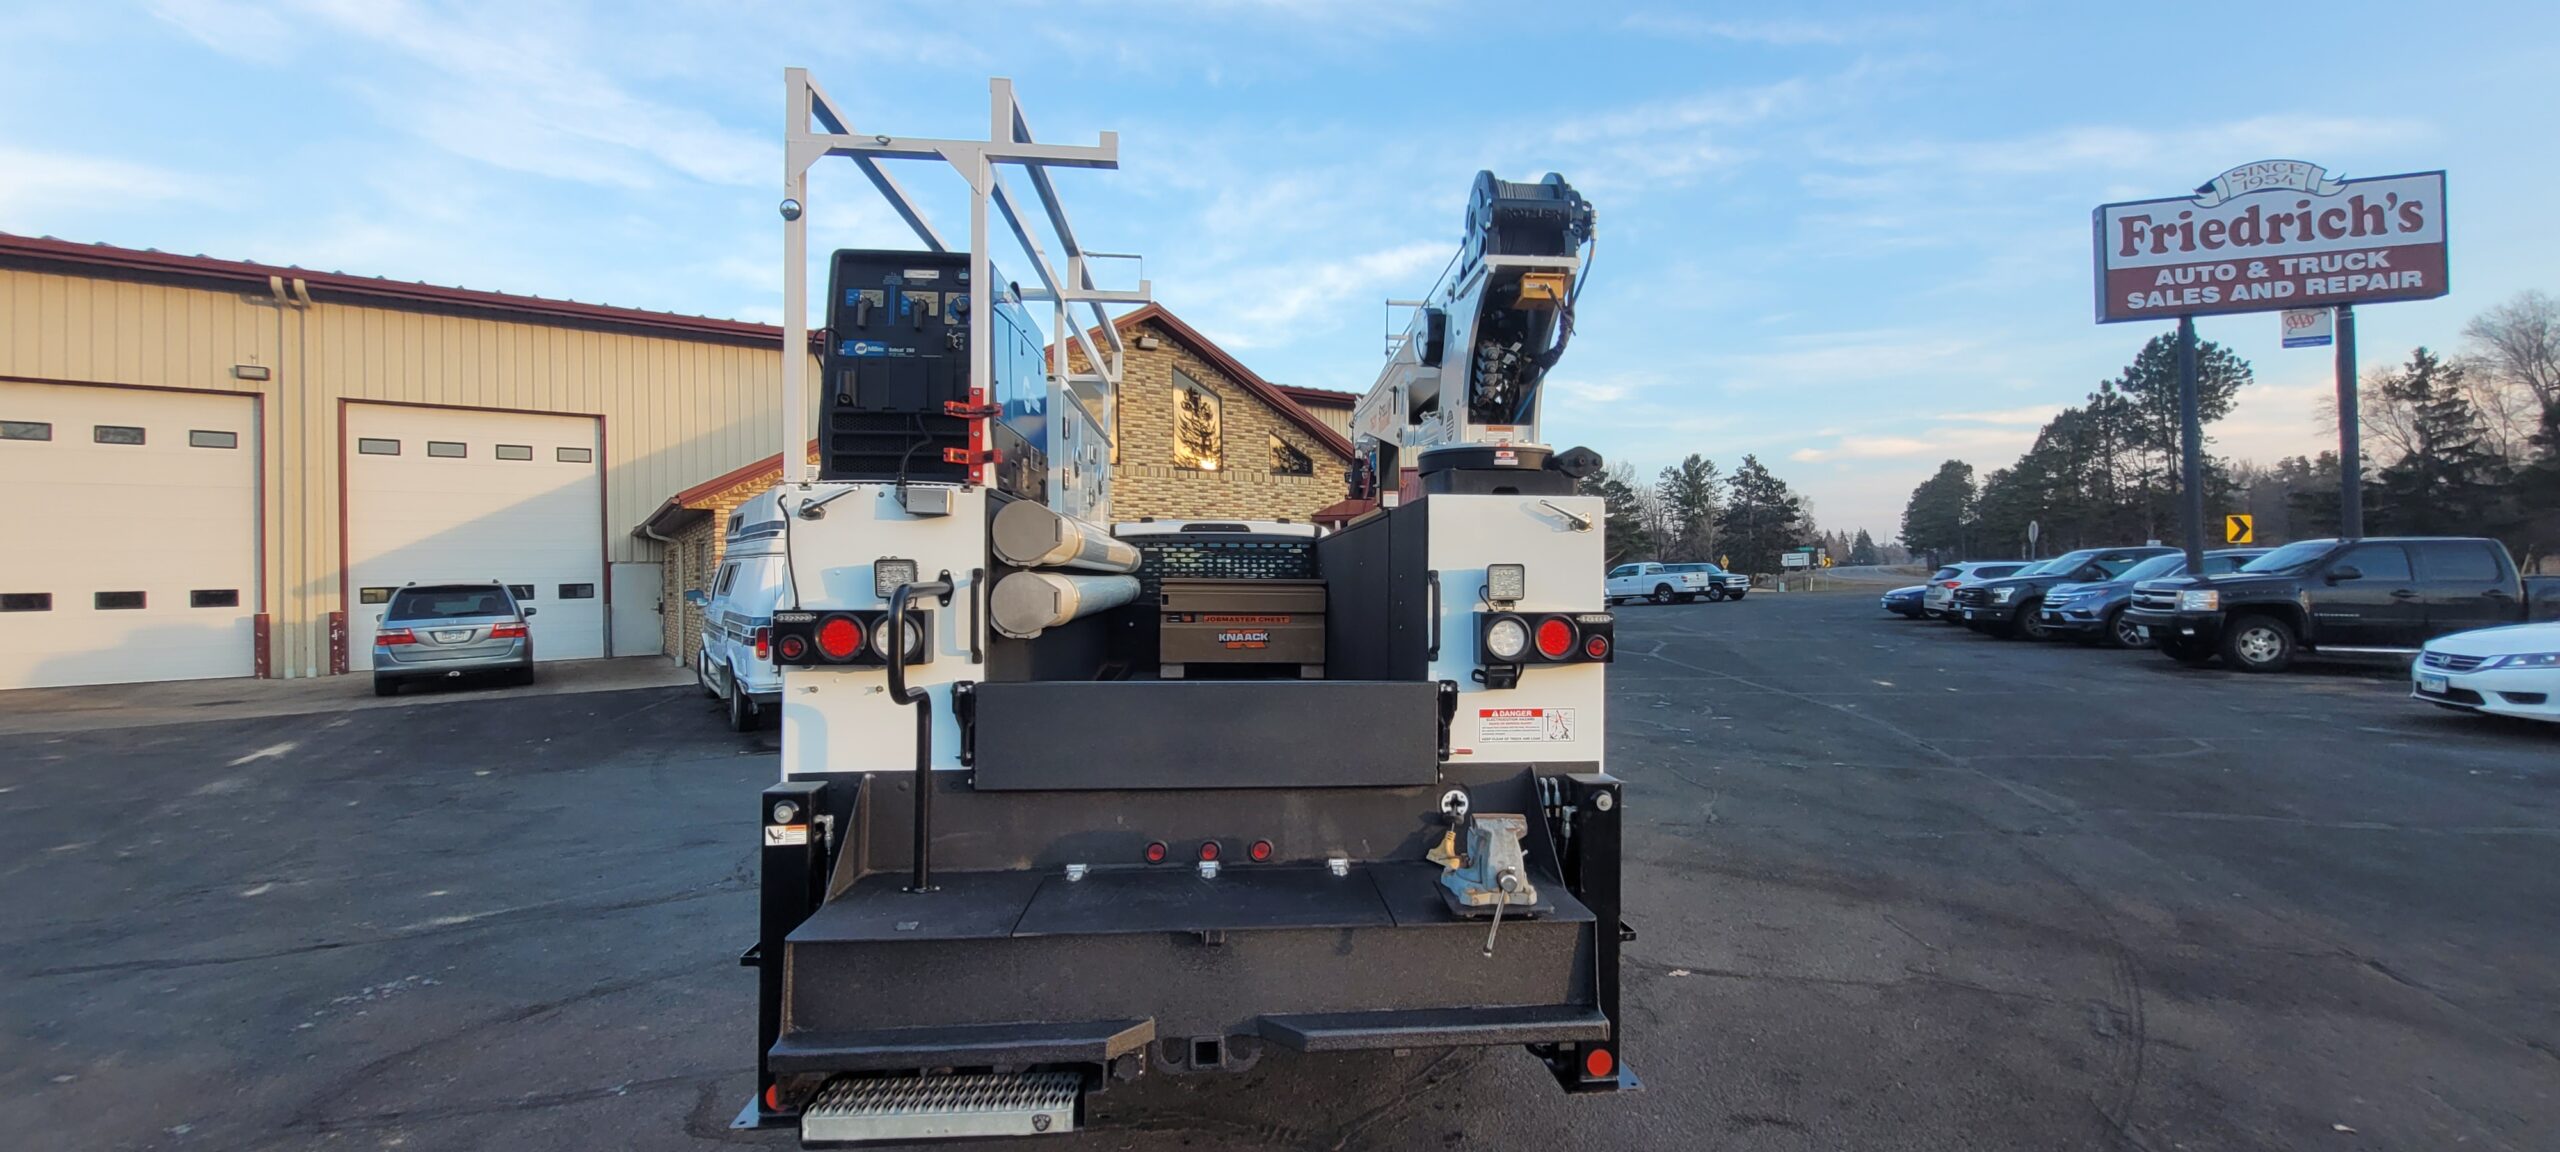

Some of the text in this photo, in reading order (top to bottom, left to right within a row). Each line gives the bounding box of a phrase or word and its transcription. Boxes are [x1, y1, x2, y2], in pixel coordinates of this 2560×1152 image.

[2232, 163, 2304, 183] SINCE
[2243, 174, 2296, 190] 1954
[2118, 192, 2424, 257] Friedrich's
[2155, 250, 2391, 286] AUTO & TRUCK
[2127, 271, 2423, 309] SALES AND REPAIR
[1218, 632, 1269, 642] KNAACK
